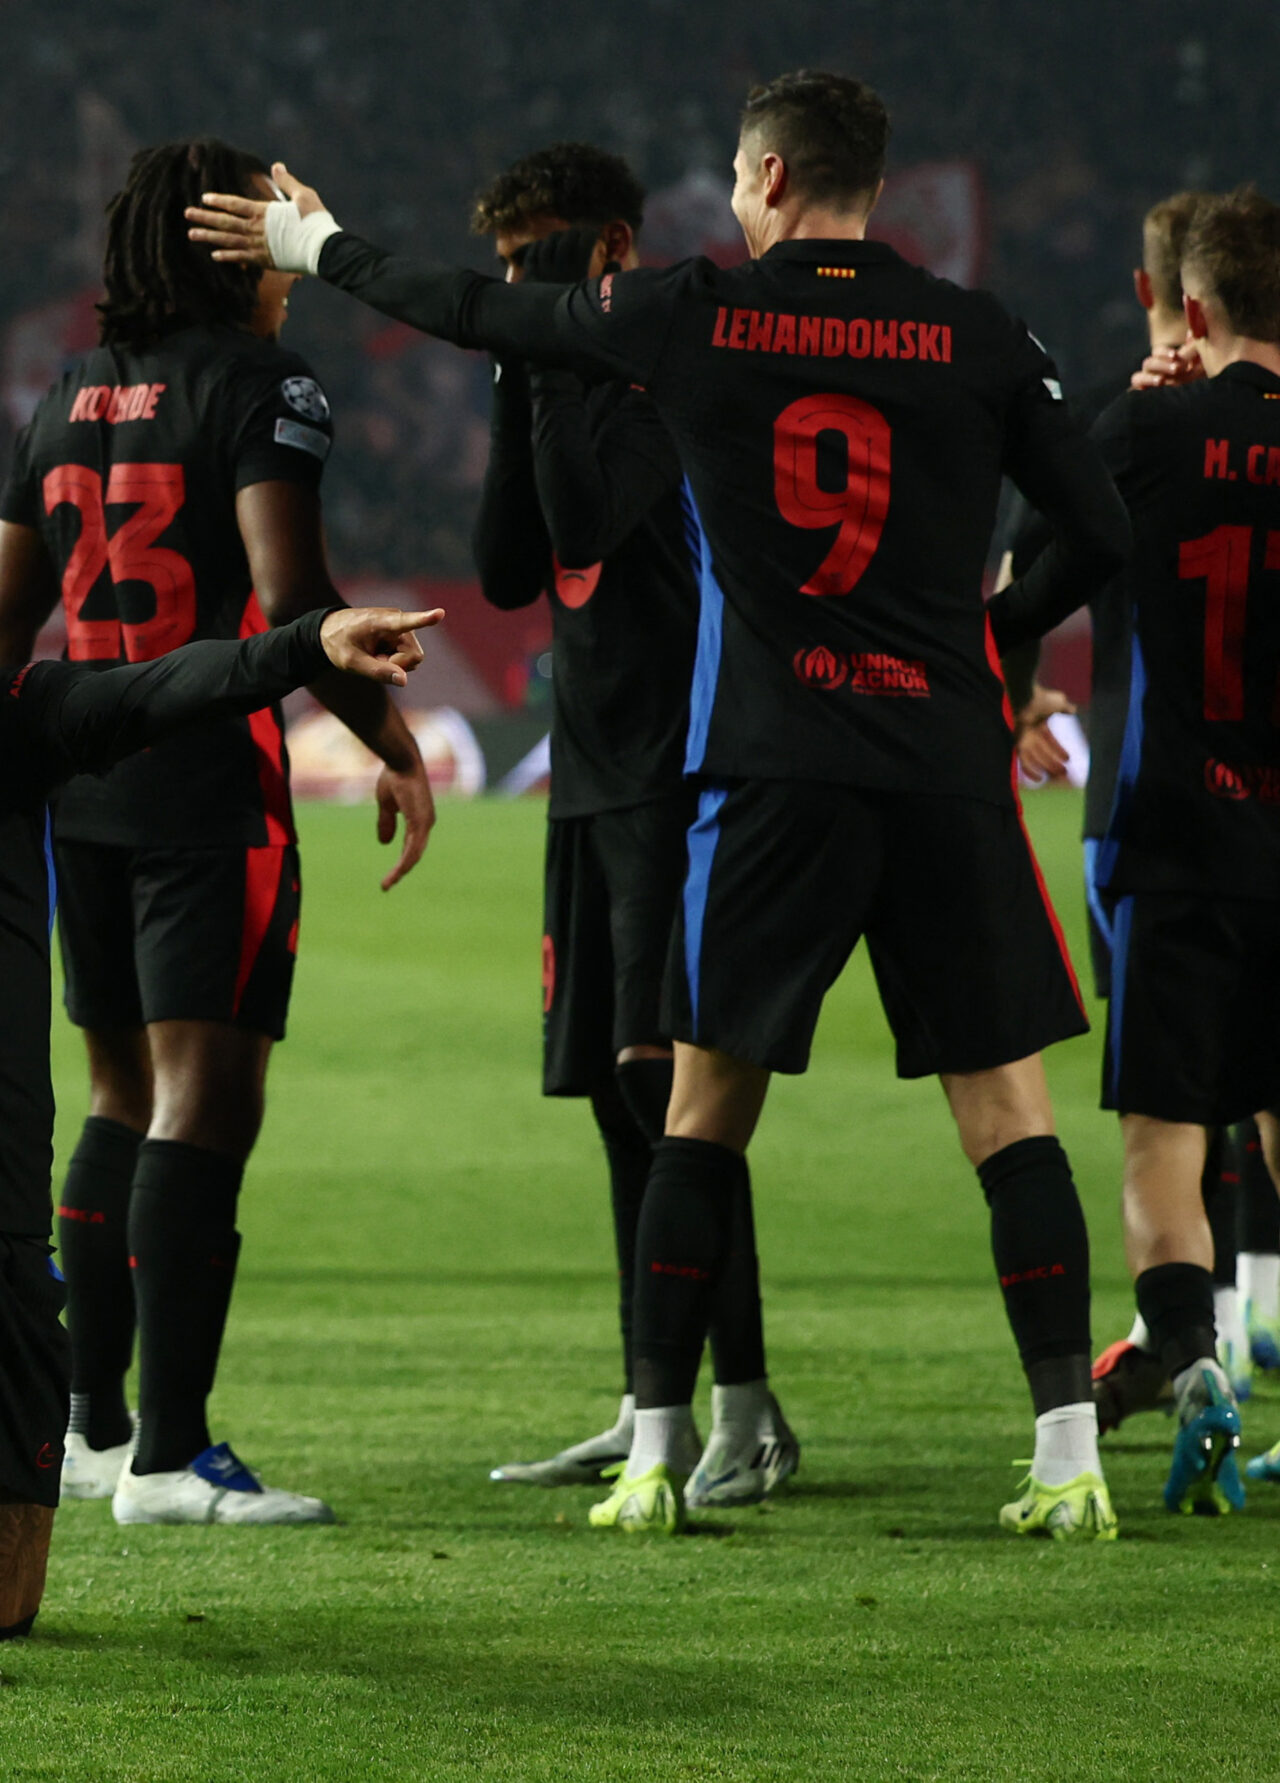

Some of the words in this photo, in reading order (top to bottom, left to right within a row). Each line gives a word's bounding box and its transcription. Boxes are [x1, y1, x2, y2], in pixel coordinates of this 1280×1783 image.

[711, 306, 953, 364] LEWANDOWSKI
[773, 392, 892, 597] 9
[1203, 437, 1239, 482] M.
[42, 462, 196, 662] 23
[1177, 524, 1280, 721] 1
[851, 669, 930, 692] ACNUR
